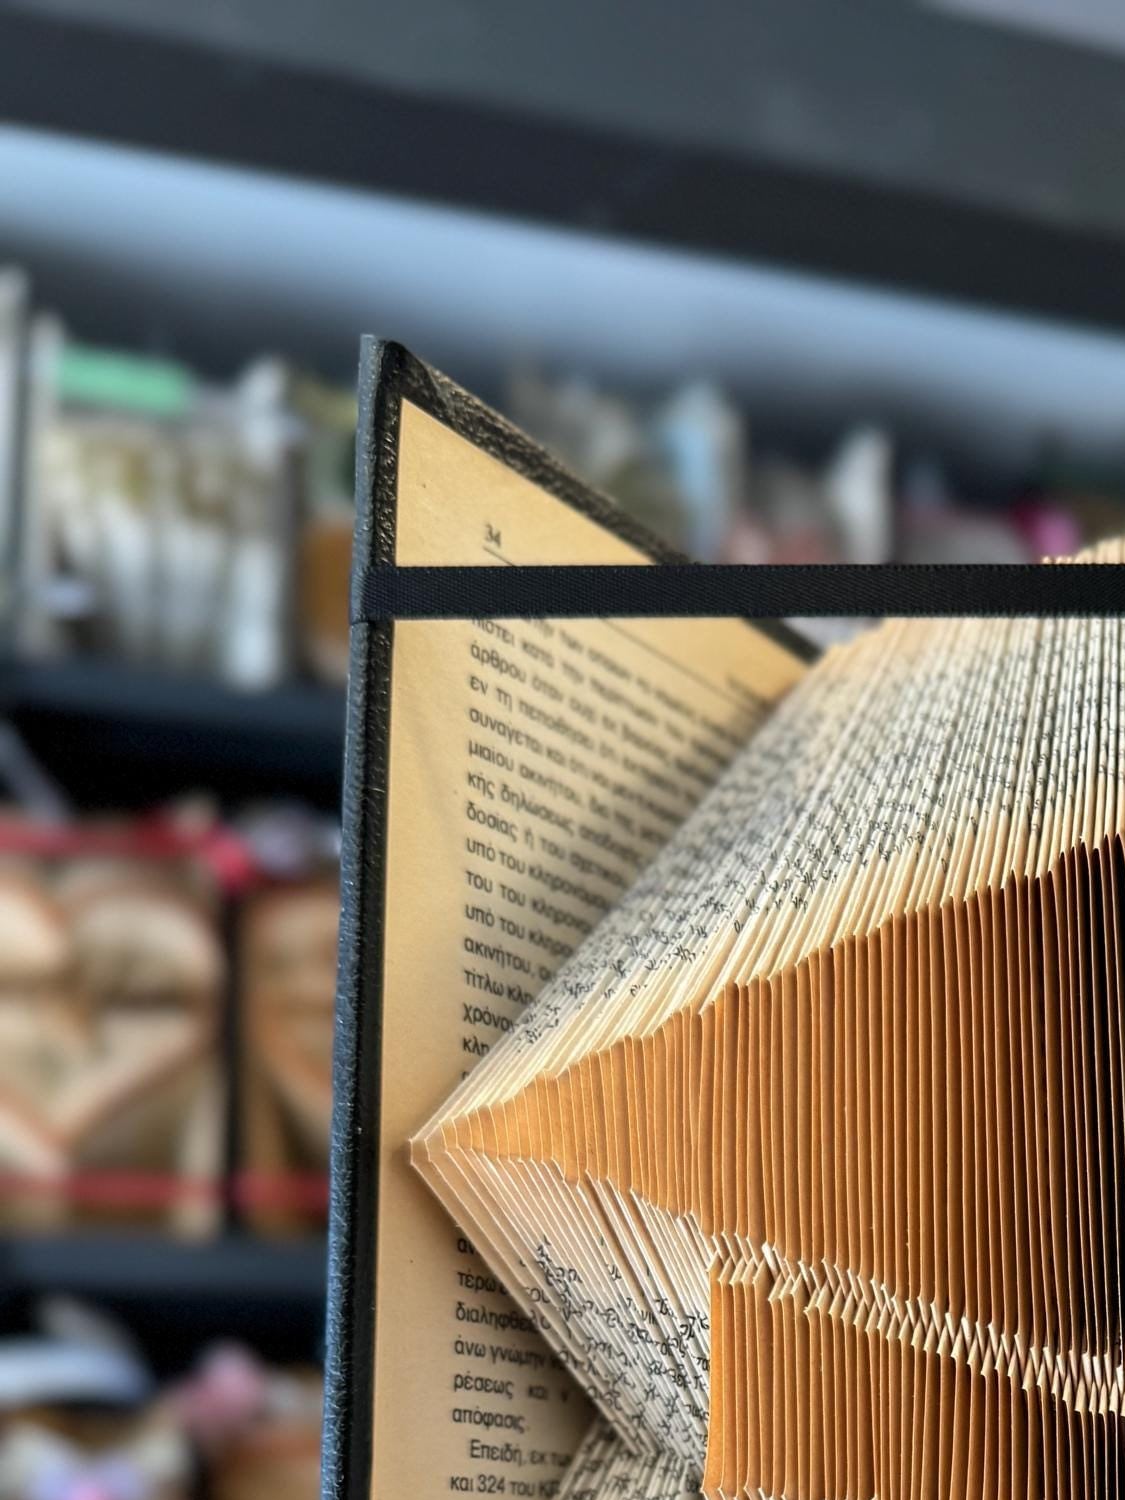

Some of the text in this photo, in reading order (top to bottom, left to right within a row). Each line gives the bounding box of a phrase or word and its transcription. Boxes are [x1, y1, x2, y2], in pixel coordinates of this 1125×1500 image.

[484, 523, 501, 548] 34
[470, 640, 527, 684] άρθρου
[470, 675, 489, 697] εν
[468, 740, 515, 772] μιαίου
[468, 772, 497, 801] κής
[466, 800, 518, 844] δοσίας
[466, 836, 496, 862] υπό
[499, 851, 526, 875] του
[465, 869, 493, 894] του
[499, 884, 526, 907] του
[465, 903, 496, 928] υπό
[499, 917, 526, 940] του
[463, 967, 505, 997] τίτλω
[454, 1334, 487, 1358] άνω
[454, 1371, 514, 1400] ρέσεως
[450, 1476, 474, 1492] και
[478, 1474, 505, 1494] 324
[510, 1480, 535, 1498] του
